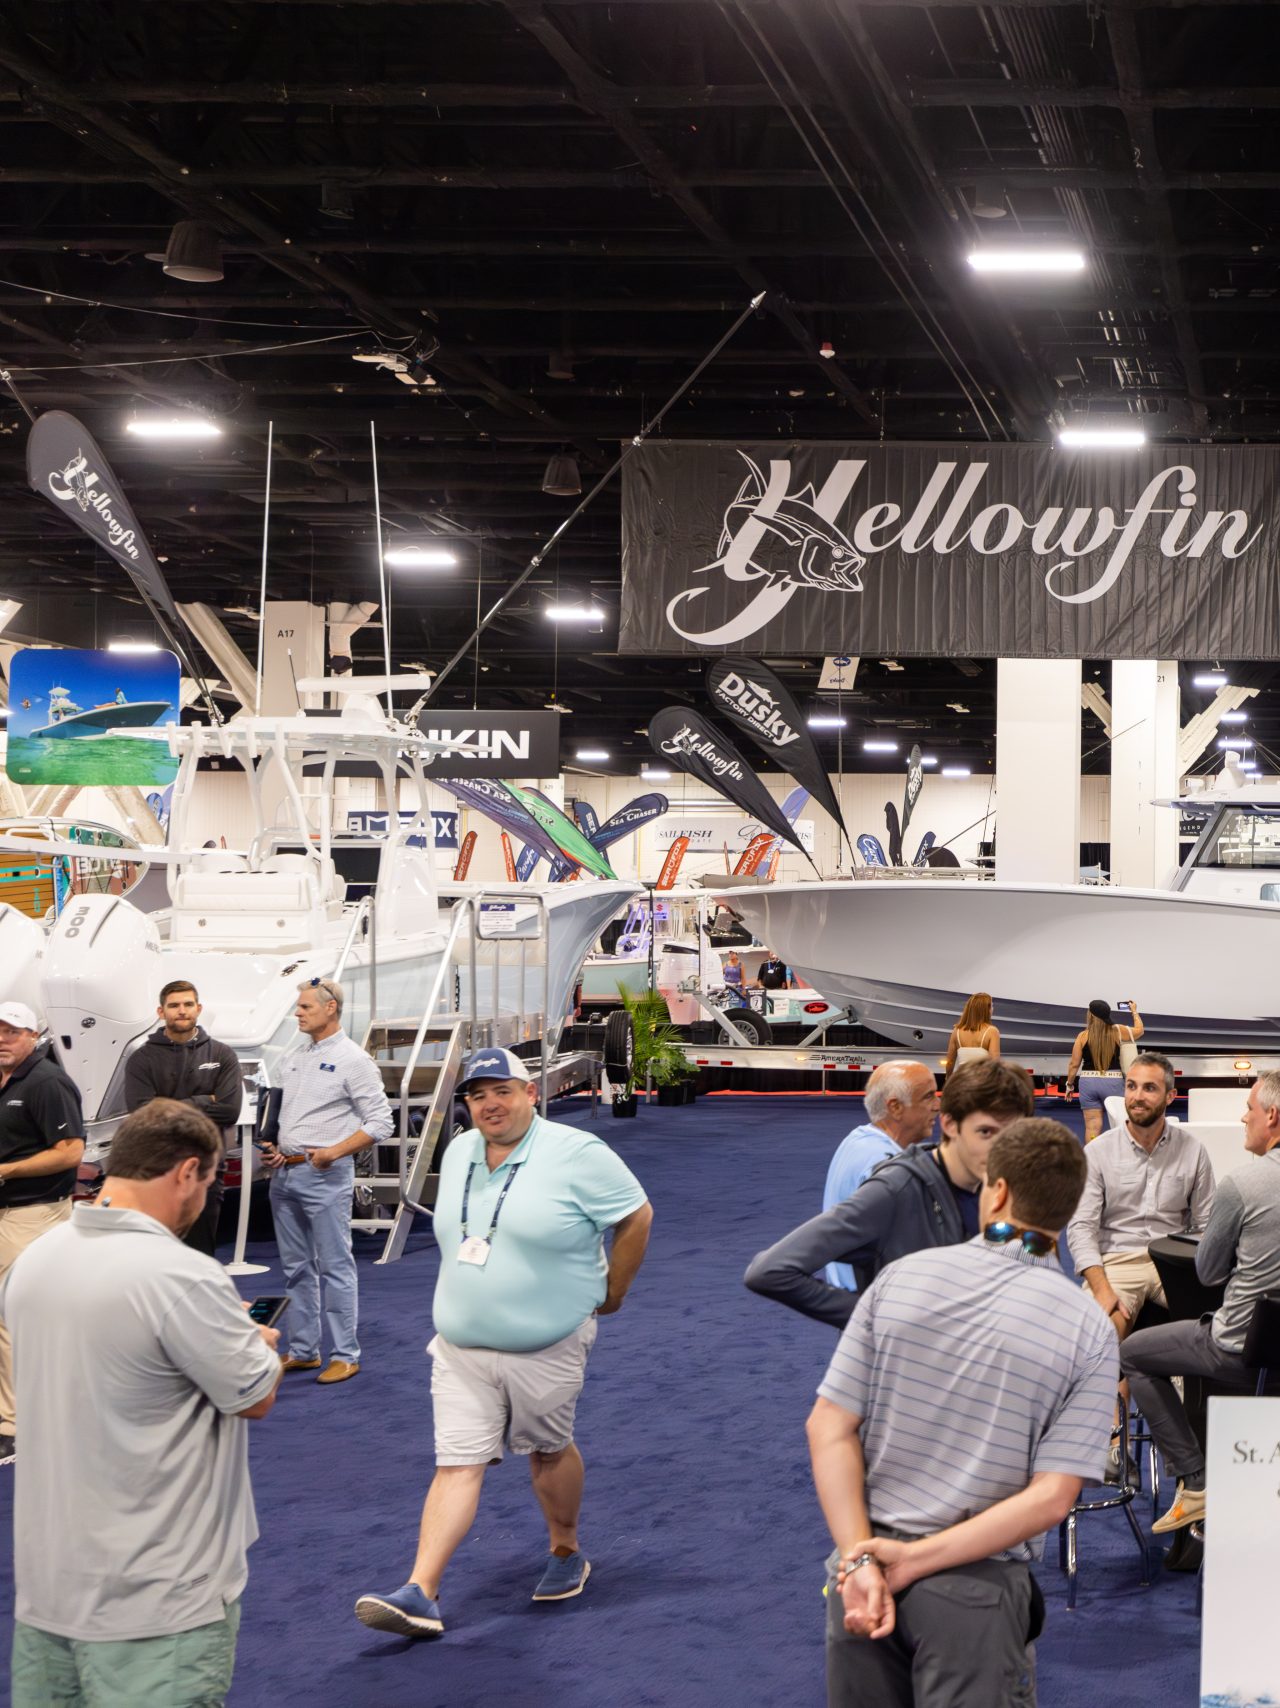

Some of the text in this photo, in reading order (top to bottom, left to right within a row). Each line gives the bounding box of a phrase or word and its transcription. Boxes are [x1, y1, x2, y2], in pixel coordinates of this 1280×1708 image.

[48, 456, 139, 559] Yellowfin
[666, 455, 1263, 645] Yellowfin
[278, 629, 294, 638] A17
[715, 688, 775, 739] FACTORY DIRECT
[718, 672, 800, 746] Dusky
[660, 726, 744, 781] Yellowfin
[627, 808, 657, 821] CHASER
[65, 906, 90, 938] 300
[1232, 1440, 1264, 1465] St.
